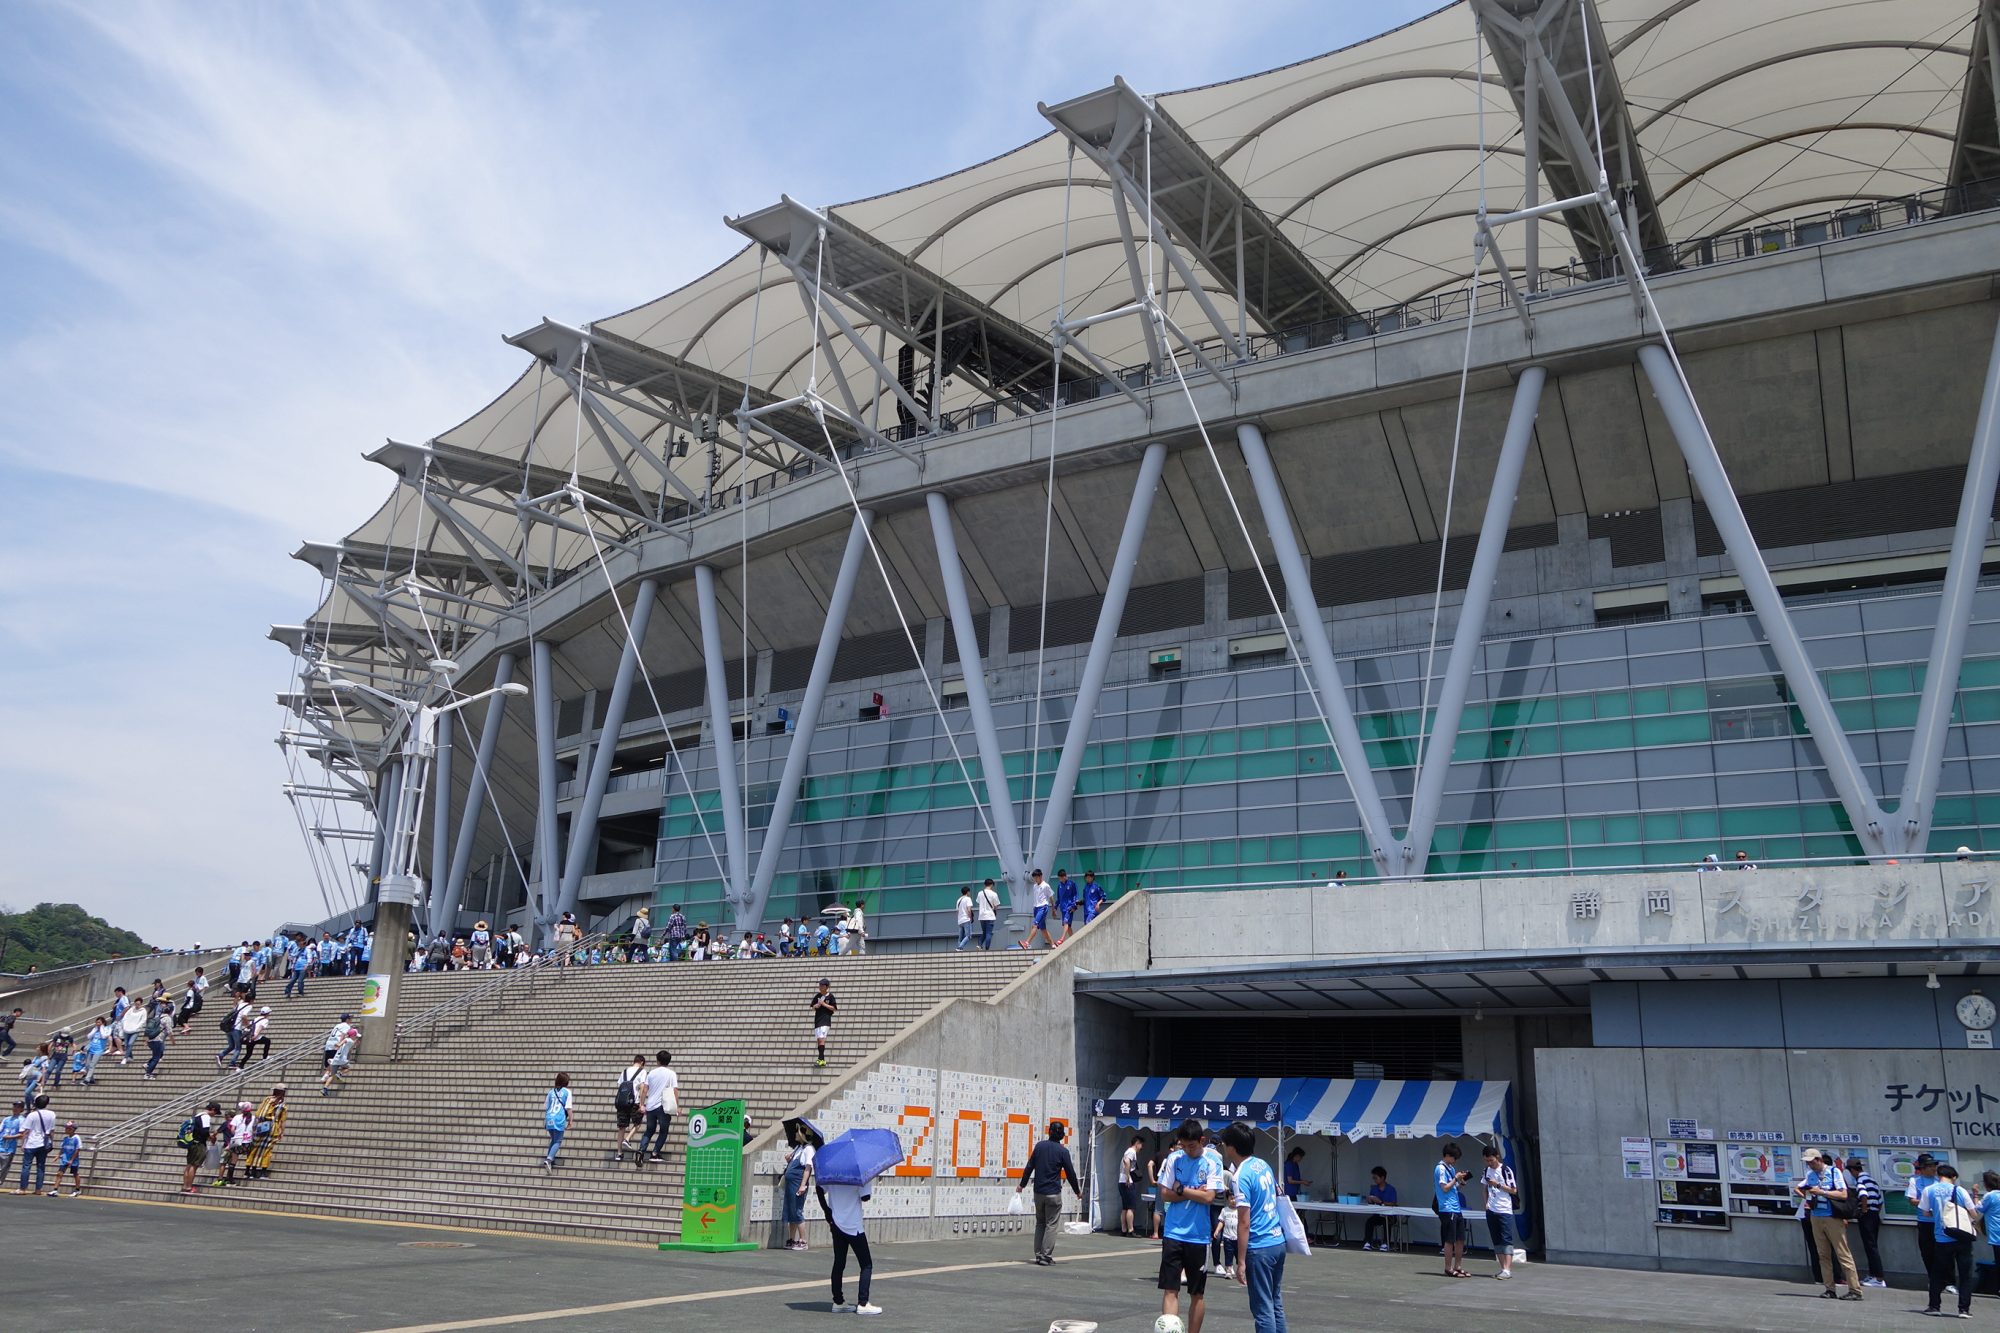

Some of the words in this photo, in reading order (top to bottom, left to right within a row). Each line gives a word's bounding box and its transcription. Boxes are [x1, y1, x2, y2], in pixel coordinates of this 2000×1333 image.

[1750, 914, 1893, 932] SHIZUOKA
[1884, 1083, 1999, 1114] チケット
[712, 1106, 740, 1115] スタジアム
[1119, 1102, 1249, 1117] 各種チケット引換
[694, 1119, 702, 1134] 6
[1728, 1132, 1754, 1141] 前売券
[1758, 1132, 1784, 1141] 当日券
[1803, 1133, 1829, 1142] 前売券
[1833, 1134, 1860, 1143] 当日券
[1880, 1135, 1908, 1144] 前売券
[1912, 1136, 1940, 1146] 当日券
